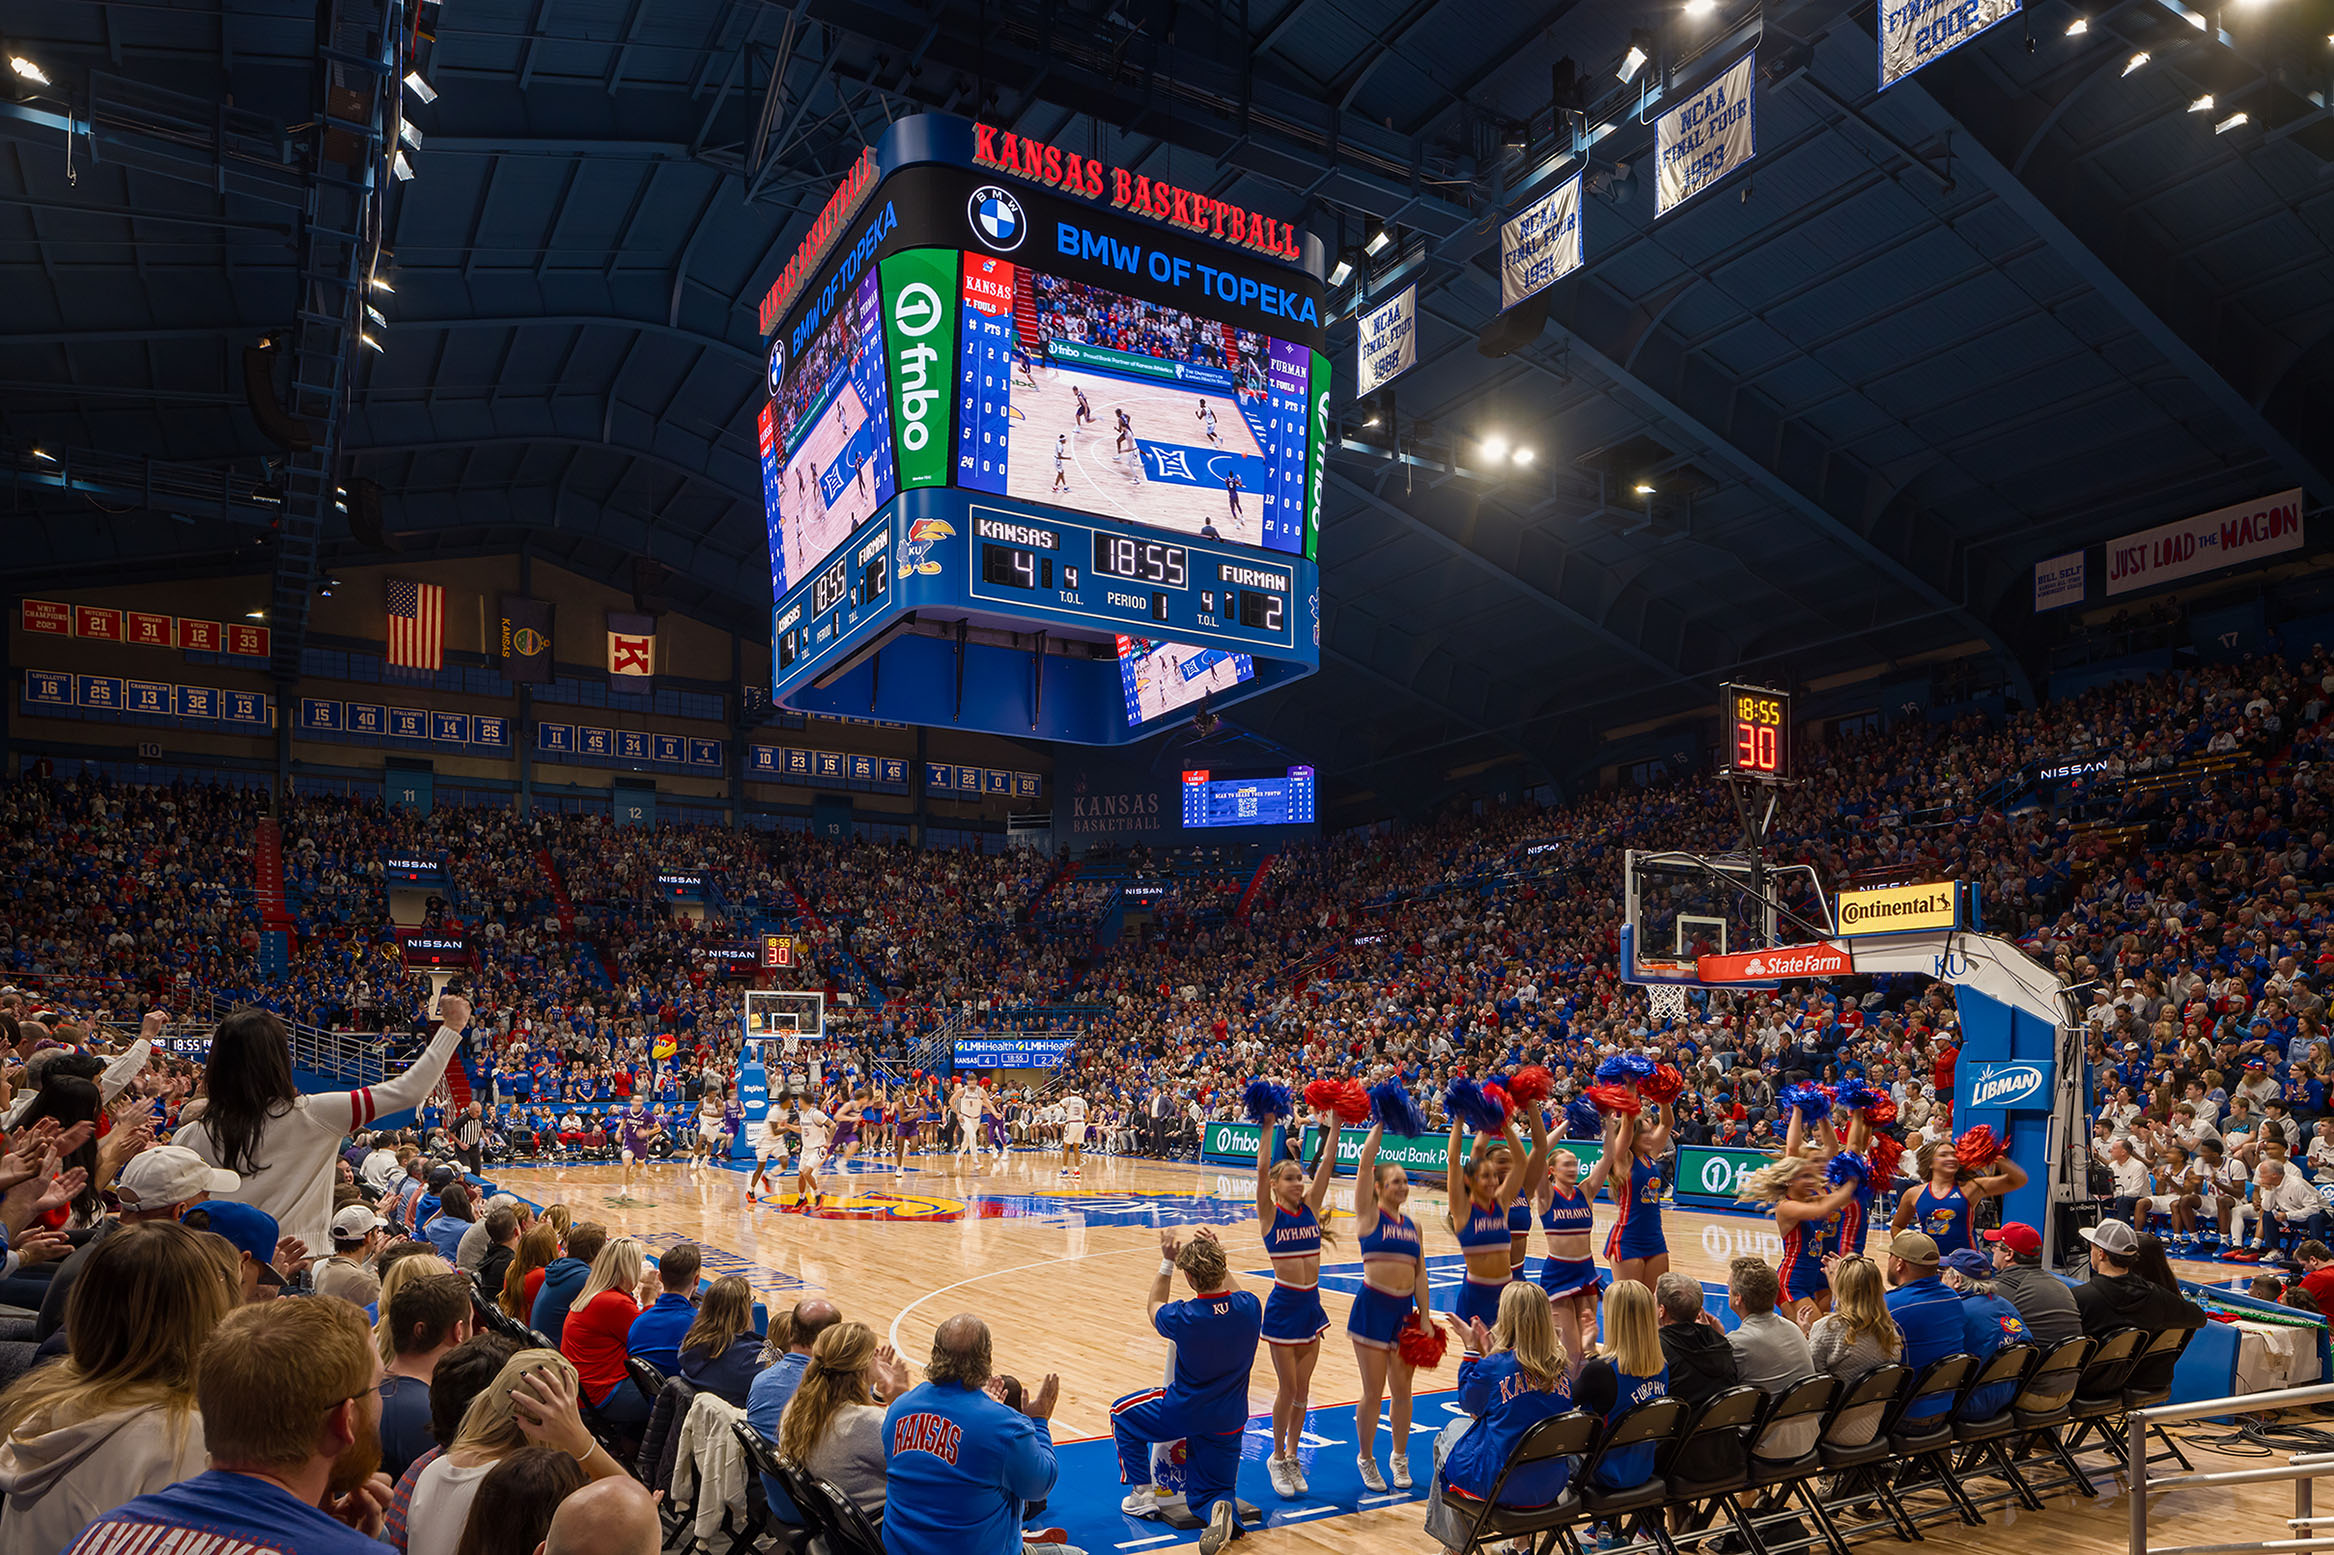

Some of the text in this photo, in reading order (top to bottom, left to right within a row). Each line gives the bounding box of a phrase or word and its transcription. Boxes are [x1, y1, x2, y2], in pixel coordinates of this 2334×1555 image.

[1915, 0, 1979, 57] 2002
[1680, 86, 1727, 135] NCAA
[1662, 98, 1747, 168] FINAL FOUR
[974, 121, 1300, 259] KANSAS BASKETBALL
[976, 189, 1019, 213] BMW
[1519, 200, 1559, 241] NCAA
[759, 144, 872, 335] KANSAS BASKETBALL
[1504, 212, 1577, 271] FINAL FOUR
[792, 297, 821, 358] BMW
[822, 271, 839, 317] OF
[839, 200, 898, 293] TOPEKA
[1057, 221, 1319, 329] BMW OF TOPEKA
[966, 275, 1012, 300] KANSAS
[973, 299, 997, 314] FOULS
[1003, 307, 1009, 318] 1
[1373, 302, 1401, 337] NCAA
[984, 322, 1001, 336] PTS
[1004, 327, 1011, 338] F
[1362, 316, 1413, 361] FINAL FOUR
[967, 342, 1009, 363] 1 2 0
[1270, 358, 1307, 378] FURMAN
[1373, 349, 1400, 381] 1988
[900, 342, 939, 451] fnbo
[1276, 379, 1295, 392] FOULS
[1299, 386, 1305, 396] 0
[979, 518, 1052, 549] KANSAS
[2110, 502, 2299, 581] JUST LOAD THE WAGON
[857, 529, 889, 569] FURMAN
[908, 545, 923, 556] KU
[1109, 538, 1184, 585] 18:55
[1222, 565, 1286, 592] FURMAN
[2059, 565, 2082, 579] SELF
[816, 559, 846, 613] 18:55
[1014, 551, 1035, 588] 4
[1064, 567, 1077, 588] 4
[1201, 591, 1213, 611] 4
[1265, 594, 1283, 631] 2
[1059, 590, 1084, 606] T.O.L.
[1107, 591, 1147, 610] PERIOD
[786, 629, 795, 659] 4
[816, 624, 831, 645] PERIOD
[876, 556, 886, 594] 2
[89, 616, 108, 632] 21
[778, 603, 801, 634] KANSAS
[1197, 613, 1220, 628] T.O.L.
[239, 634, 258, 648] 33
[501, 616, 512, 659] KANSAS
[2216, 631, 2240, 649] 17
[613, 635, 649, 674] K
[40, 680, 59, 695] 16
[89, 685, 111, 700] 25
[141, 690, 158, 705] 13
[237, 700, 253, 714] 13
[314, 708, 330, 722] 15
[1738, 697, 1780, 725] 18:55
[358, 712, 376, 726] 40
[442, 721, 457, 734] 14
[551, 731, 562, 745] 11
[587, 735, 604, 749] 45
[625, 738, 641, 752] 34
[1738, 723, 1775, 769] 30
[141, 743, 160, 756] 10
[665, 743, 674, 755] 0
[1672, 751, 1688, 764] 15
[759, 753, 772, 765] 10
[823, 759, 836, 771] 15
[887, 766, 901, 778] 45
[2040, 760, 2108, 780] NISSAN
[402, 789, 415, 802] 11
[1072, 792, 1160, 817] KANSAS
[628, 807, 642, 819] 12
[827, 823, 840, 835] 13
[1073, 816, 1161, 833] BASKETBALL
[387, 859, 438, 870] NISSAN
[658, 875, 701, 885] NISSAN
[1125, 887, 1164, 895] NISSAN
[1841, 895, 1935, 925] Continental
[407, 938, 463, 949] NISSAN
[767, 937, 791, 948] 18:55
[708, 949, 755, 959] NISSAN
[767, 948, 788, 964] 30
[1933, 954, 1967, 979] KU
[173, 1039, 200, 1051] 18:55
[1041, 1057, 1047, 1065] 2
[1971, 1072, 2036, 1107] LIBMAN
[632, 1125, 638, 1134] 7
[1231, 1131, 1260, 1153] fnbo
[1408, 1147, 1436, 1164] Bank
[1552, 1208, 1592, 1222] JAYHAWKS
[1213, 1302, 1229, 1315] KU
[1499, 1370, 1572, 1405] KANAS
[1630, 1380, 1666, 1405] FURPHY
[892, 1412, 964, 1466] KANSAS
